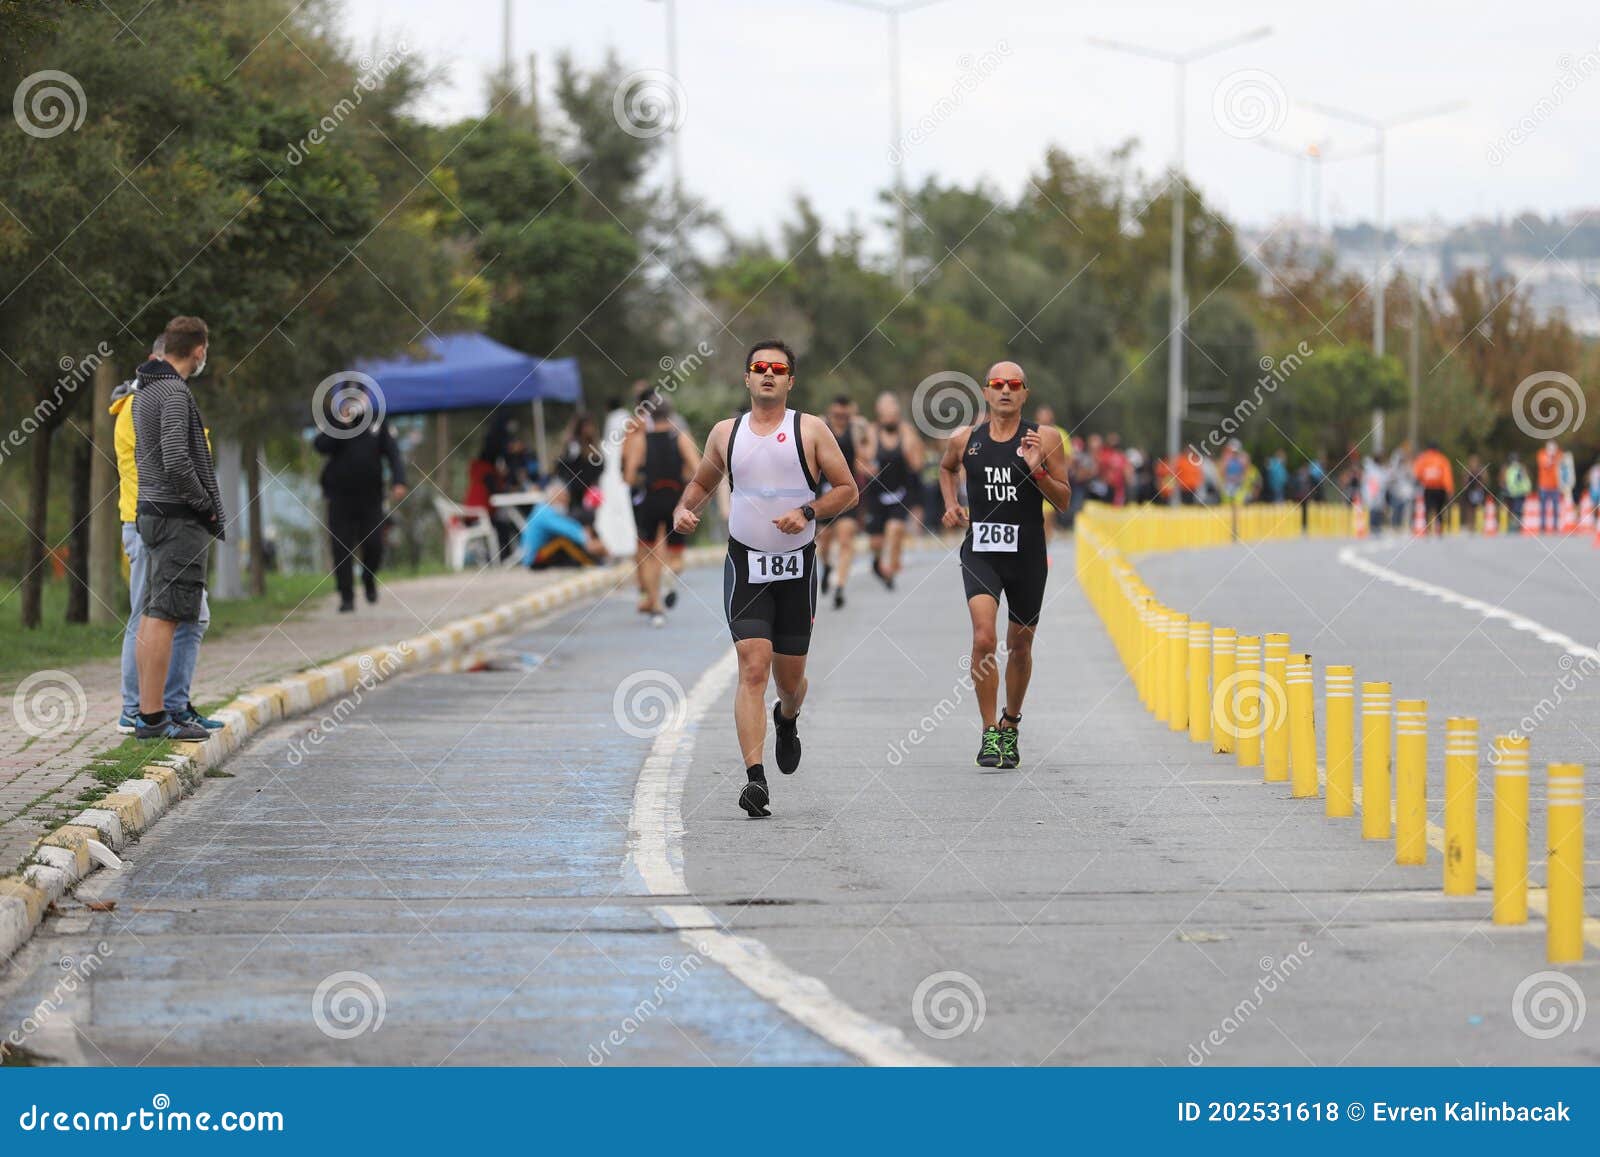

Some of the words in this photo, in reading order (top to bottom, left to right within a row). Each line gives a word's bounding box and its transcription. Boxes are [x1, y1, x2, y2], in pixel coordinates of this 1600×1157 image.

[984, 466, 1011, 484] TAN
[984, 485, 1018, 502] TUR
[980, 524, 1015, 544] 268
[757, 555, 799, 576] 184
